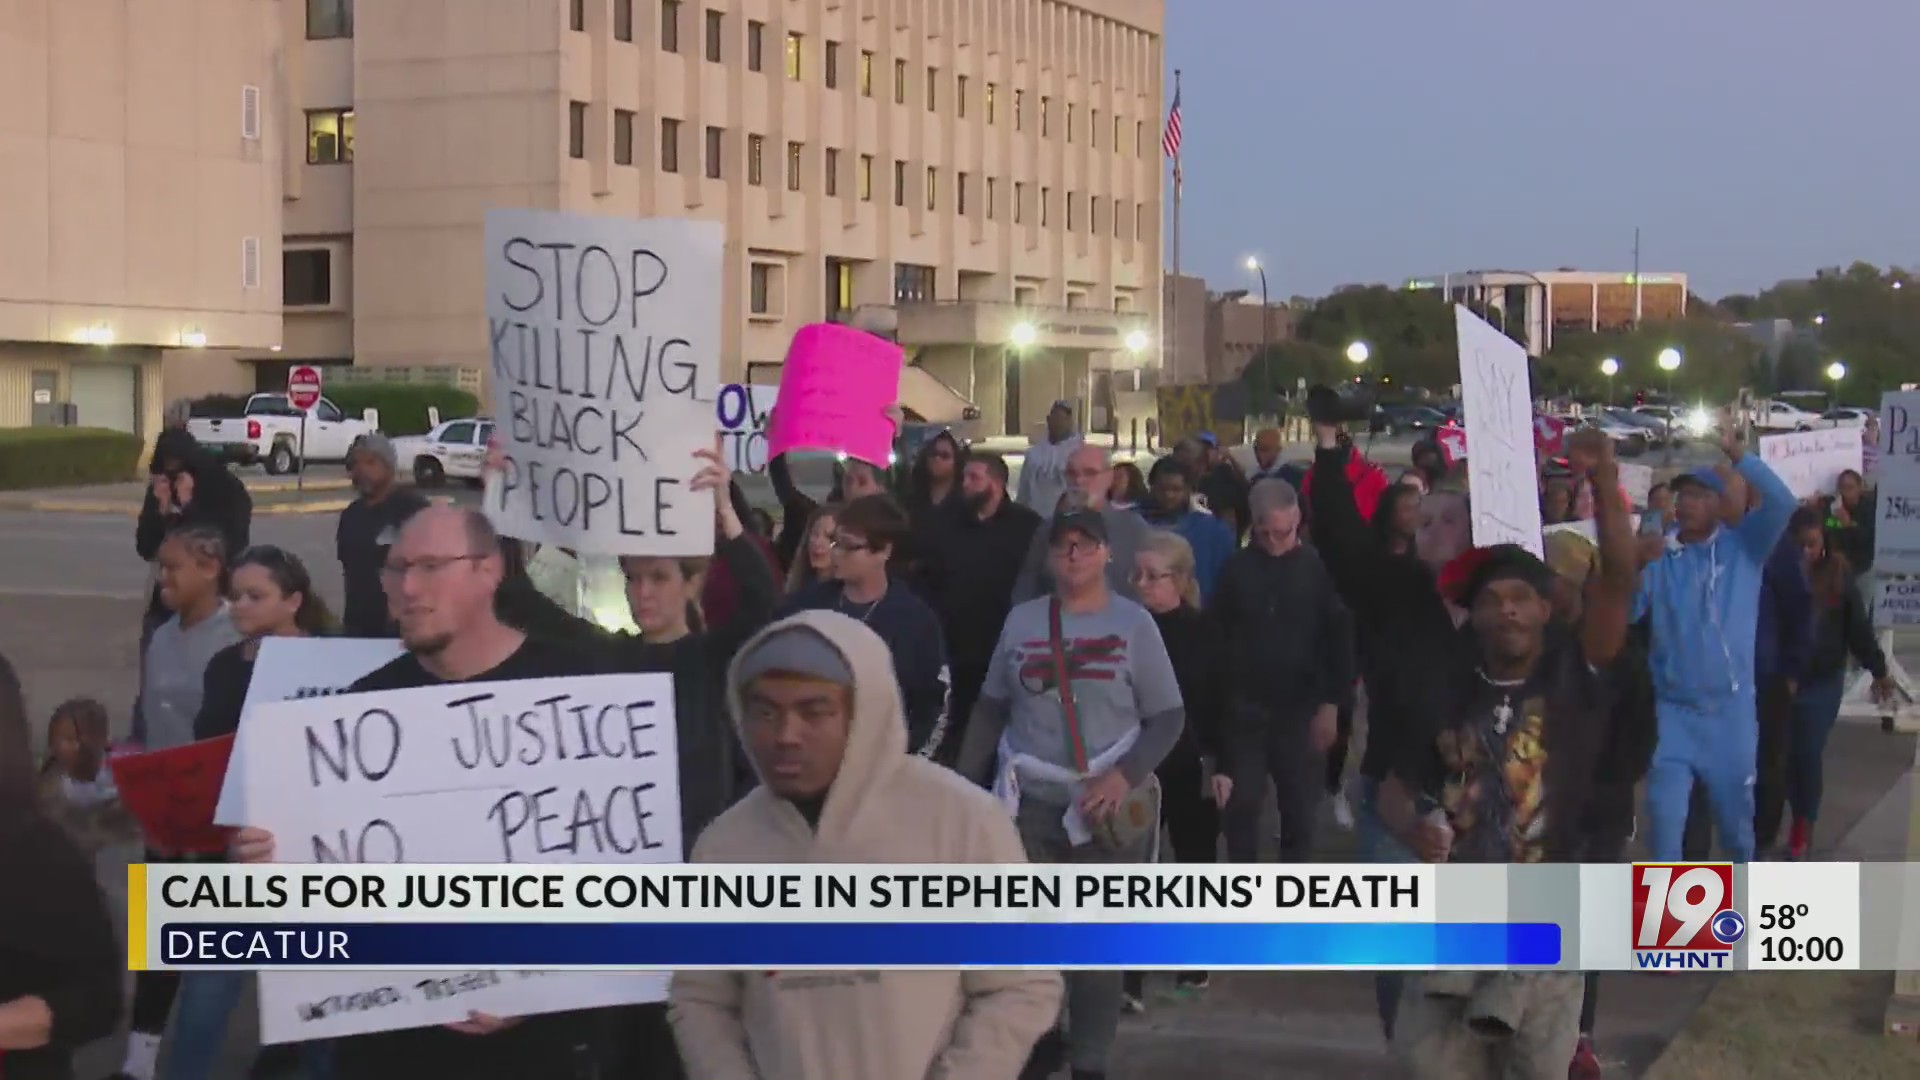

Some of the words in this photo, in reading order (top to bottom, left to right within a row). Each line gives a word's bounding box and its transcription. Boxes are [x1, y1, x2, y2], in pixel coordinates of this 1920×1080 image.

[503, 237, 668, 328] STOP
[490, 316, 698, 402] KILLING
[510, 391, 649, 462] BLACK
[501, 455, 680, 535] PEOPLE
[305, 708, 402, 787] NO
[446, 693, 658, 769] JUSTICE
[487, 783, 663, 862] PEACE
